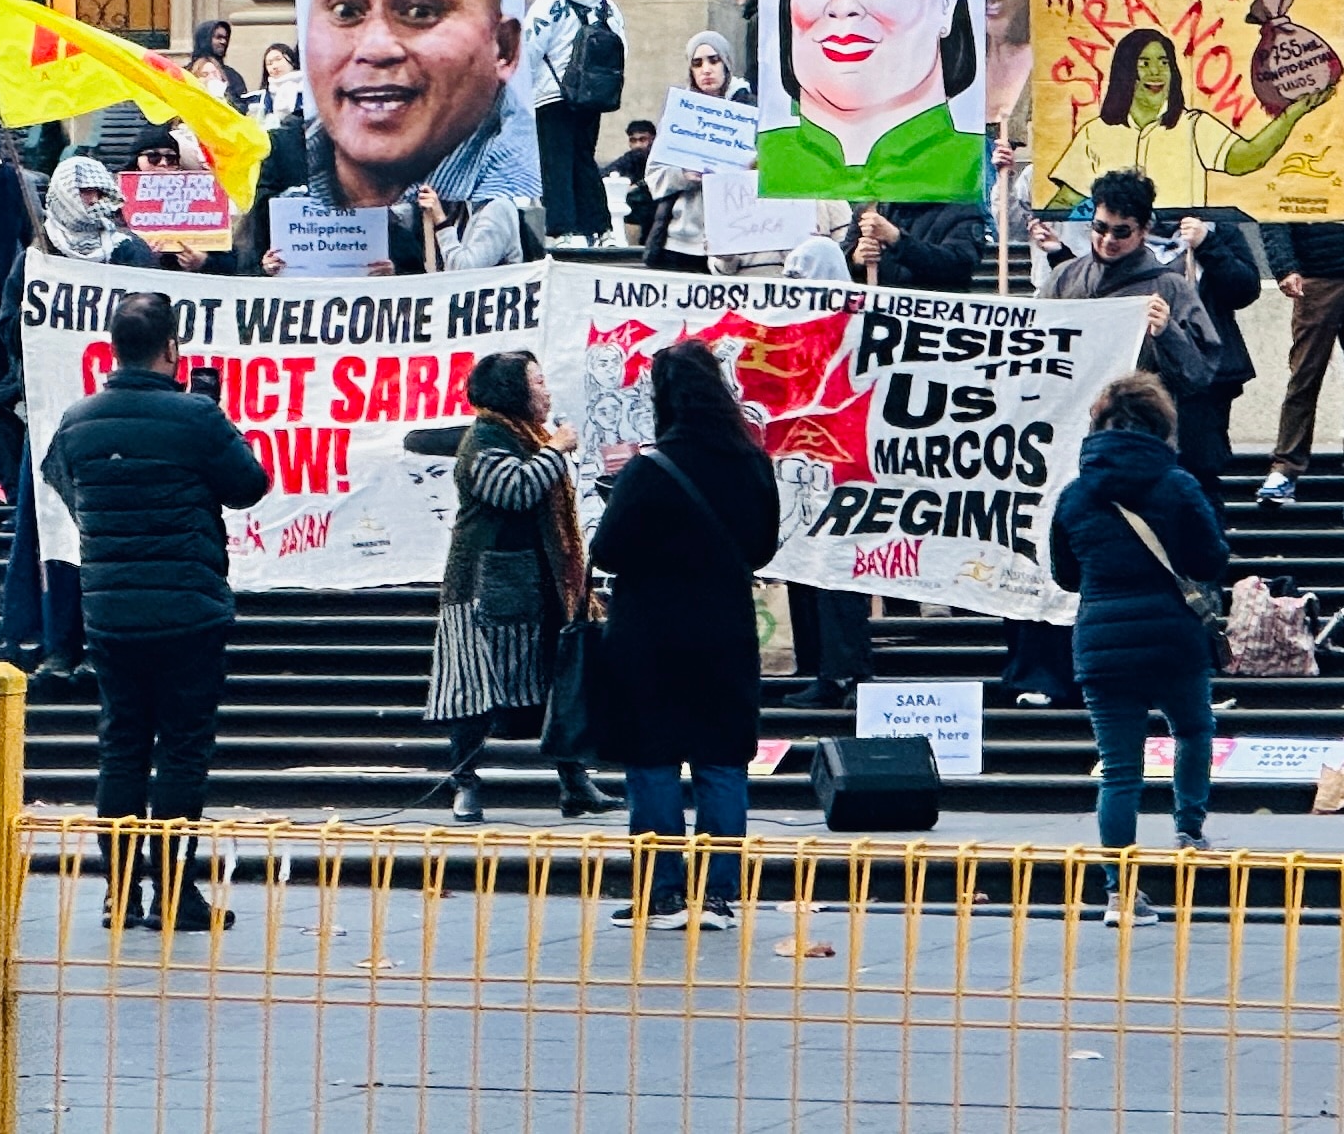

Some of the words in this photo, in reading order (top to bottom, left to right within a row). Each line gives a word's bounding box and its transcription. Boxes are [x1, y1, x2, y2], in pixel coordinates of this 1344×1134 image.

[1170, 0, 1257, 128] NOW
[139, 174, 185, 188] FUNDS
[186, 174, 215, 187] FOR
[162, 199, 193, 213] NOT
[288, 222, 367, 238] Philippines,
[291, 242, 315, 252] not
[317, 239, 368, 252] Duterte
[174, 298, 223, 345] OT
[235, 296, 434, 346] WELCOME
[447, 280, 542, 339] HERE
[593, 278, 668, 308] LAND!
[676, 283, 750, 311] JOBS!
[873, 293, 1037, 328] LIBERATION!
[855, 311, 1083, 377] RESIST
[974, 357, 1075, 380] THE
[882, 372, 998, 429] US
[874, 420, 1054, 488] MARCOS
[806, 486, 1044, 566] REGIME
[852, 536, 924, 579] BAYAN
[882, 712, 931, 725] You're
[933, 713, 958, 725] not
[937, 728, 970, 741] here
[1249, 744, 1332, 753] CONVICT
[1260, 752, 1309, 760] SARA
